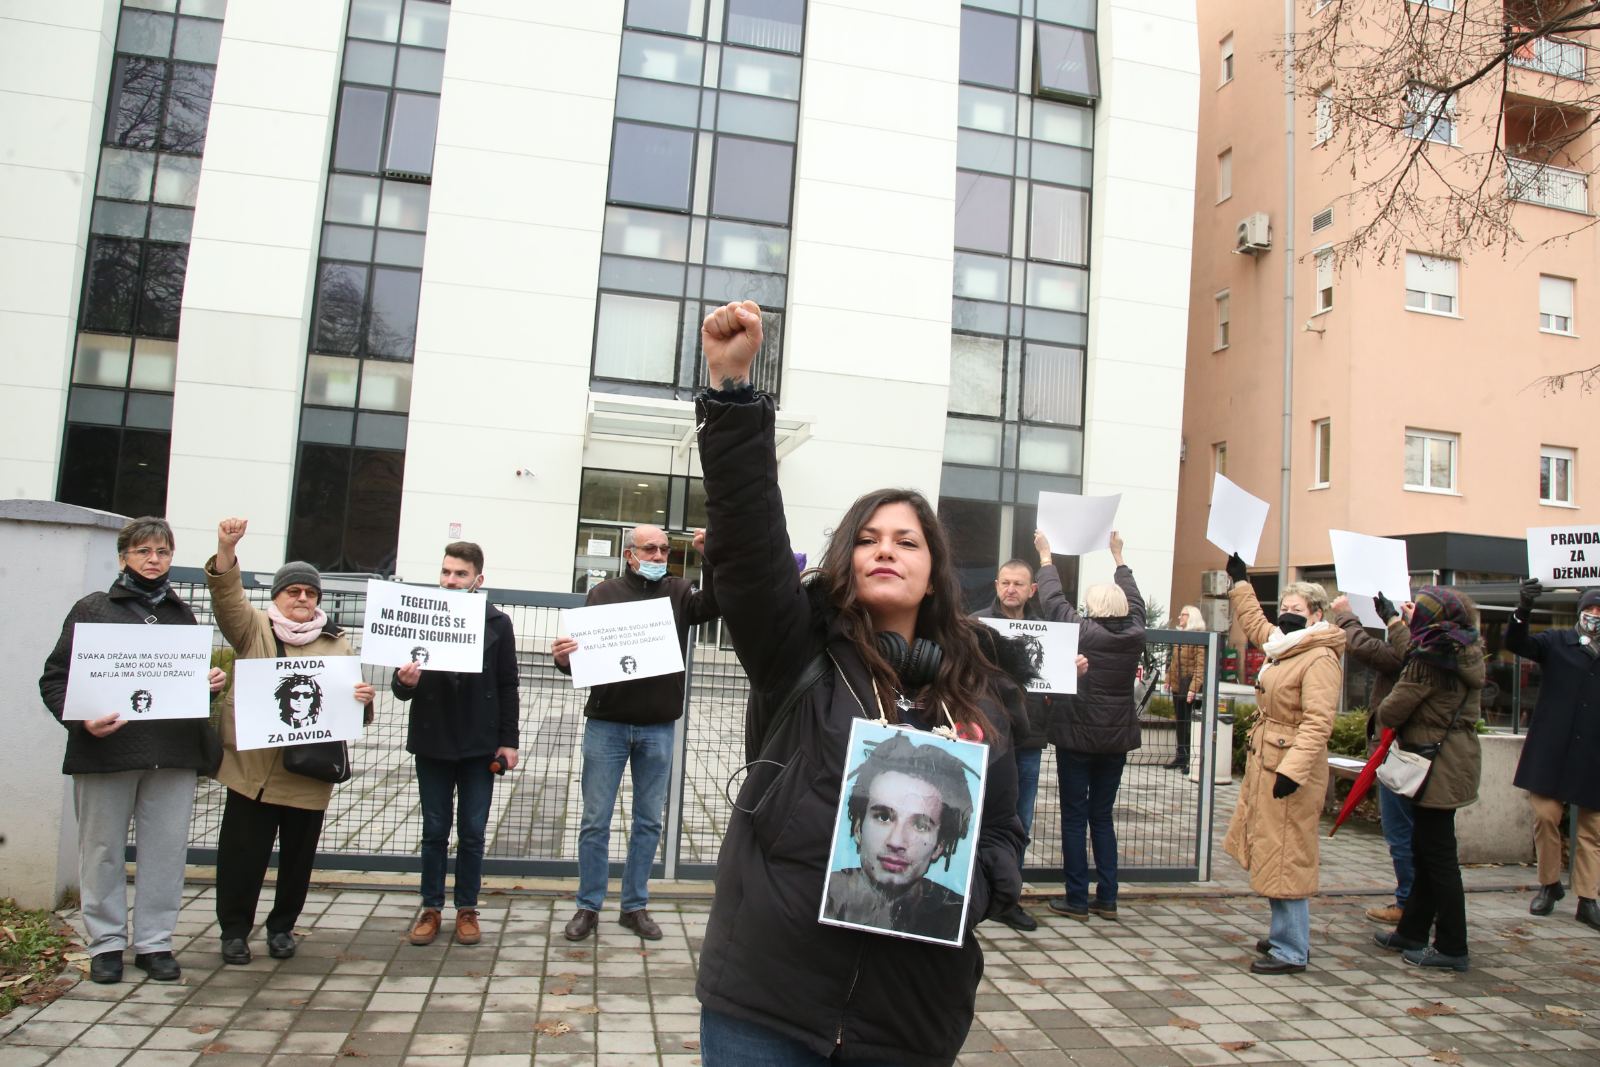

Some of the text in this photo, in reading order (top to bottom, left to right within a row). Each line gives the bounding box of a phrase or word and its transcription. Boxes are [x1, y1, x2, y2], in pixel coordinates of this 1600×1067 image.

[1551, 532, 1600, 545] PRAVDA
[1570, 550, 1585, 562] ZA
[1553, 566, 1600, 580] DžENAN
[400, 594, 450, 612] TEGELTIJA,
[381, 608, 466, 628] NA ROBIJI ĆEŠ SE
[370, 622, 476, 644] OSJEĆATI SIGURNIJE!
[1010, 622, 1048, 632] PRAVDA
[107, 652, 137, 660] DRŽAVA
[276, 660, 325, 670] PRAVDA
[164, 670, 195, 678] DRŽAVU!
[1028, 682, 1052, 690] VIDA
[268, 730, 332, 743] ZA DAVIDA
